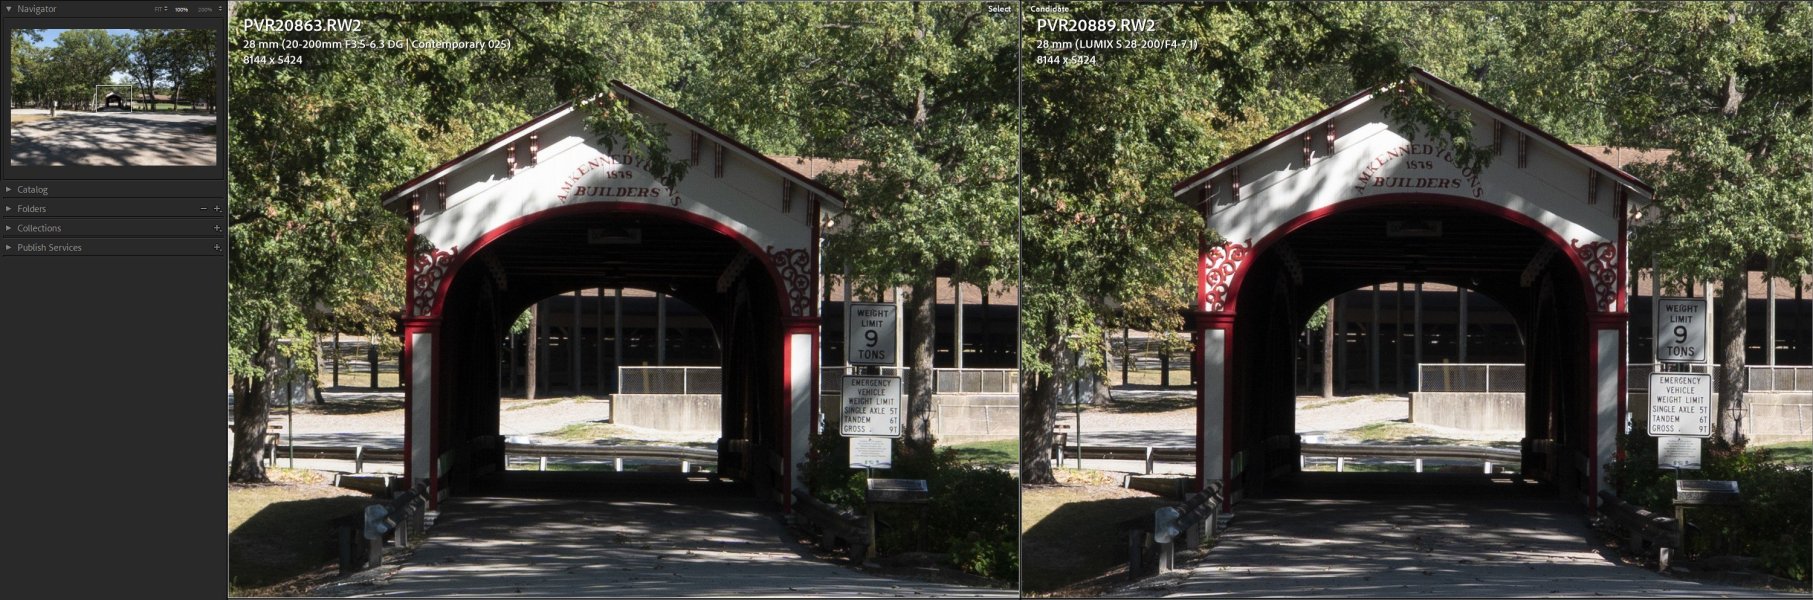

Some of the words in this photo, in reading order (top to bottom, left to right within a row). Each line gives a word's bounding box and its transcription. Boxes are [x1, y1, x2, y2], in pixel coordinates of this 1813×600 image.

[17, 5, 57, 15] Navigator
[1372, 177, 1462, 188] BUILDERS
[17, 185, 49, 196] Catalog
[574, 186, 660, 198] BUILDERS
[17, 204, 47, 213] Folders
[17, 224, 62, 232] Collections
[17, 243, 47, 252] Publish
[48, 243, 82, 252] Services
[1666, 304, 1698, 313] WEIGHT
[857, 309, 888, 318] WEIGHT
[861, 320, 884, 328] LIMIT
[865, 329, 878, 348] 9
[1673, 325, 1688, 344] 9
[858, 350, 885, 360] TONS
[1667, 346, 1695, 357] TONS
[851, 379, 891, 387] EMERGENCY
[1660, 376, 1701, 385] EMERGENCY
[858, 388, 886, 396] VEHICLE
[1666, 386, 1695, 394] VEHICLE
[876, 398, 894, 406] LIMIT
[1657, 396, 1682, 404] WEIGHT
[1685, 396, 1704, 404] LIMIT
[1652, 405, 1675, 413] SINGLE
[1678, 406, 1695, 414] AXLE
[1699, 406, 1707, 414] 5T
[844, 416, 871, 424] TANDEM
[889, 416, 897, 424] 6T
[1652, 415, 1680, 423] TANDEM
[1699, 415, 1708, 423] 6T
[844, 425, 866, 433] GROSS
[889, 425, 897, 433] 9T
